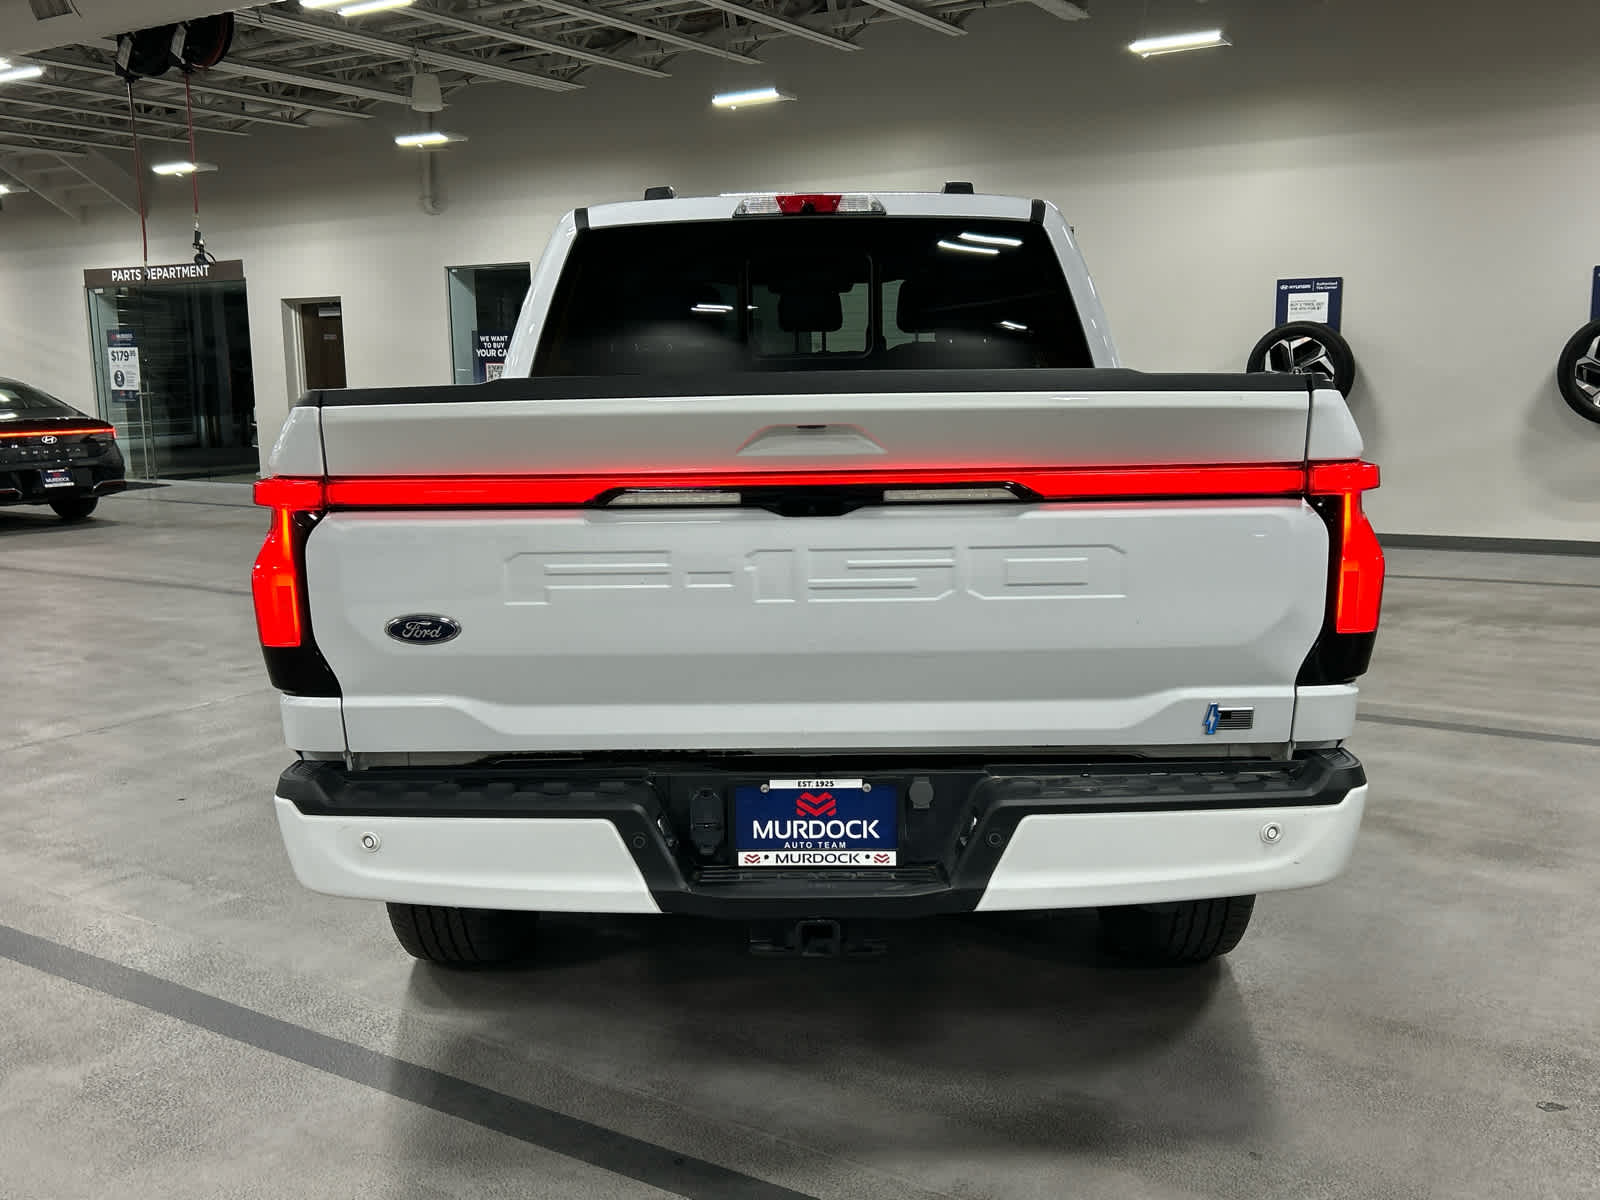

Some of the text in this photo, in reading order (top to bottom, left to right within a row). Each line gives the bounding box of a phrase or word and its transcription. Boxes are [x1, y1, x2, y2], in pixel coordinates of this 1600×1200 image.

[111, 269, 142, 282] PARTS
[111, 350, 129, 361] $179
[476, 349, 509, 357] YOUR CA
[504, 545, 1127, 605] F-150
[402, 621, 442, 638] Ford
[752, 819, 881, 839] MURDOCK
[784, 841, 813, 849] AUTO
[775, 853, 861, 864] MURDOCK
